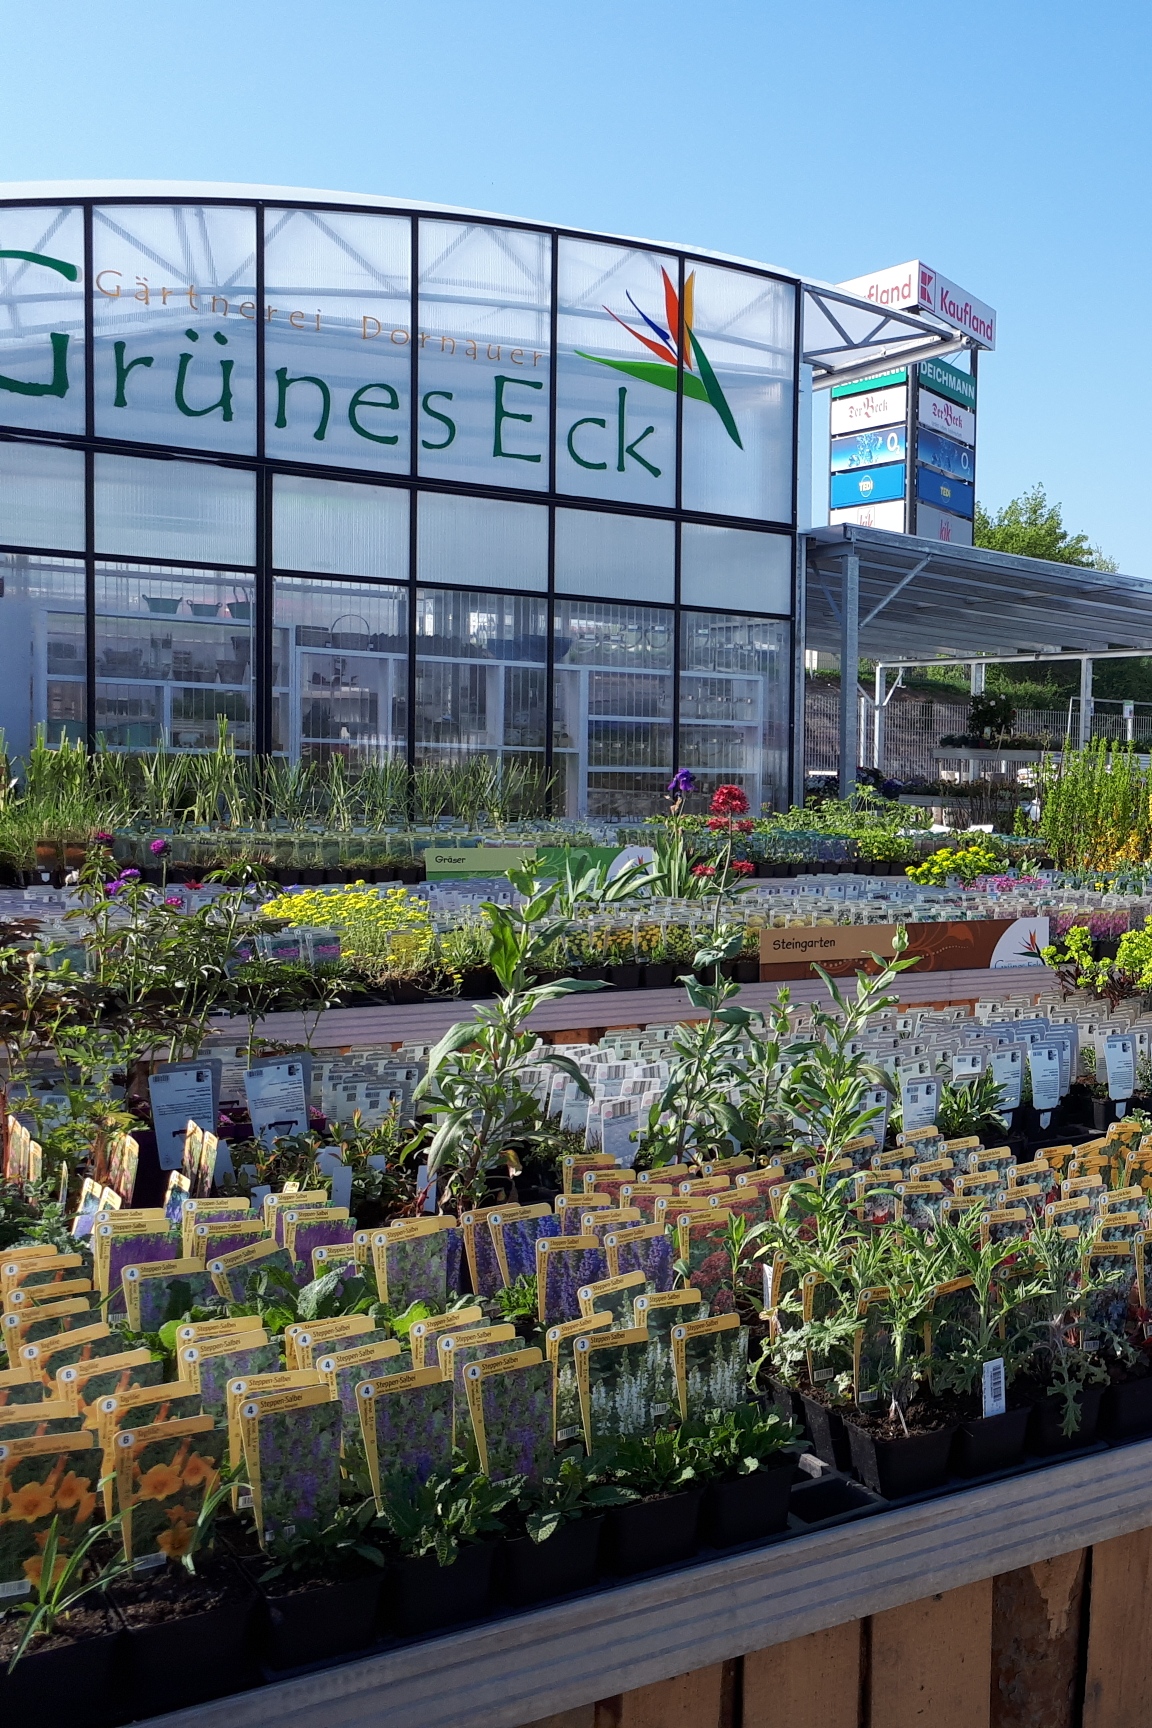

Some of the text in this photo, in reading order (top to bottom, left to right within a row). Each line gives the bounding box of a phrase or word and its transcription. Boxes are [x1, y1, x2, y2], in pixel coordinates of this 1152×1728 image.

[866, 274, 911, 305] fland
[96, 269, 542, 366] Gärtnerei Dornauer
[940, 286, 993, 341] Kaufland
[920, 362, 975, 399] DEICHMANN
[493, 374, 662, 478] Eck
[435, 855, 466, 863] Gräser
[773, 937, 836, 952] Steingarten
